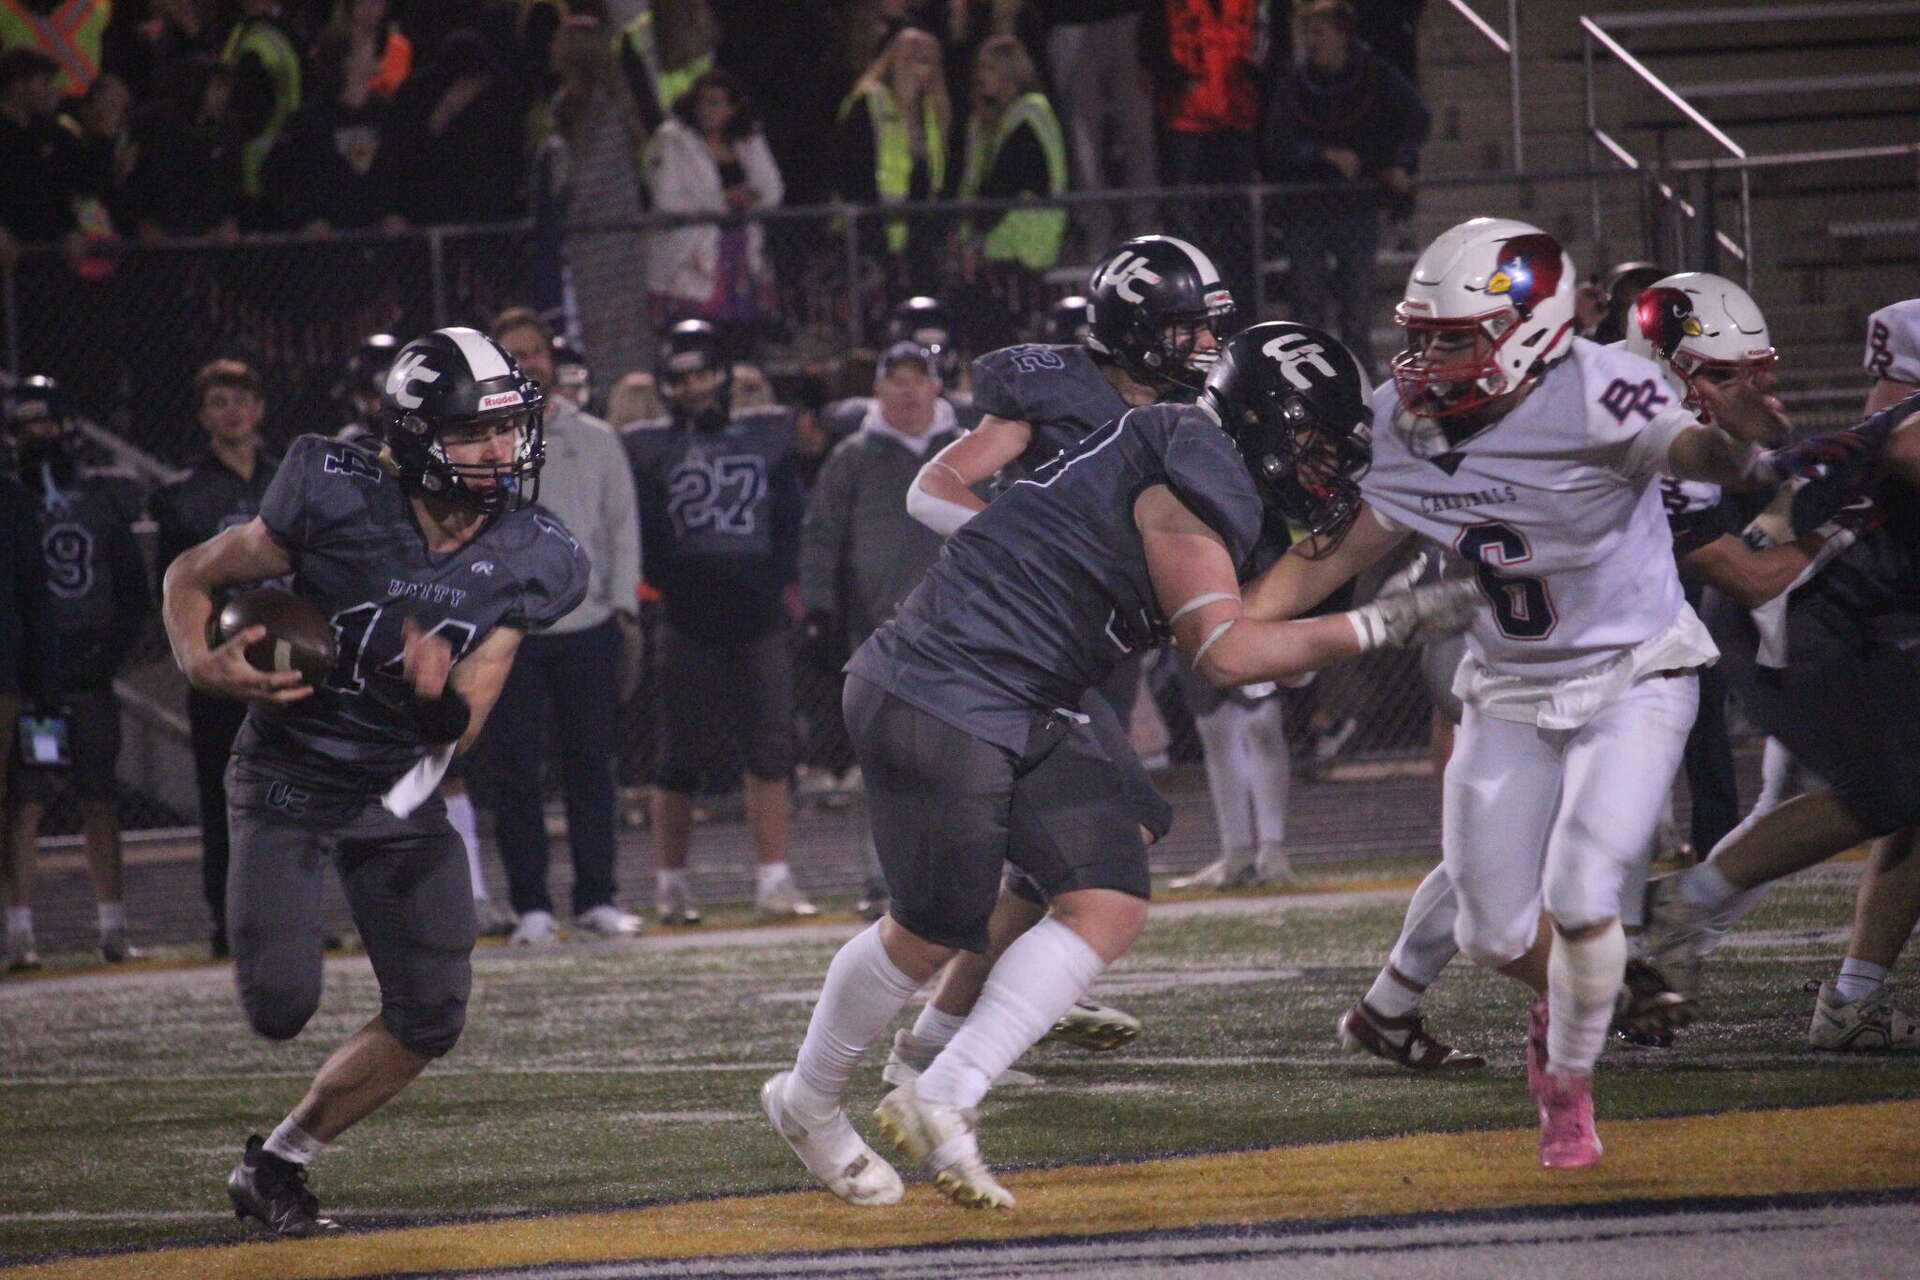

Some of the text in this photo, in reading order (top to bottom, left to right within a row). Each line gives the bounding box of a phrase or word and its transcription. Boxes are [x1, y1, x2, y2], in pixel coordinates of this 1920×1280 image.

[1104, 250, 1163, 304] UC
[385, 351, 441, 409] UC
[1262, 333, 1338, 390] UC
[1599, 378, 1668, 423] BR
[667, 455, 768, 535] 27
[42, 523, 95, 598] 9
[1453, 520, 1559, 641] 6
